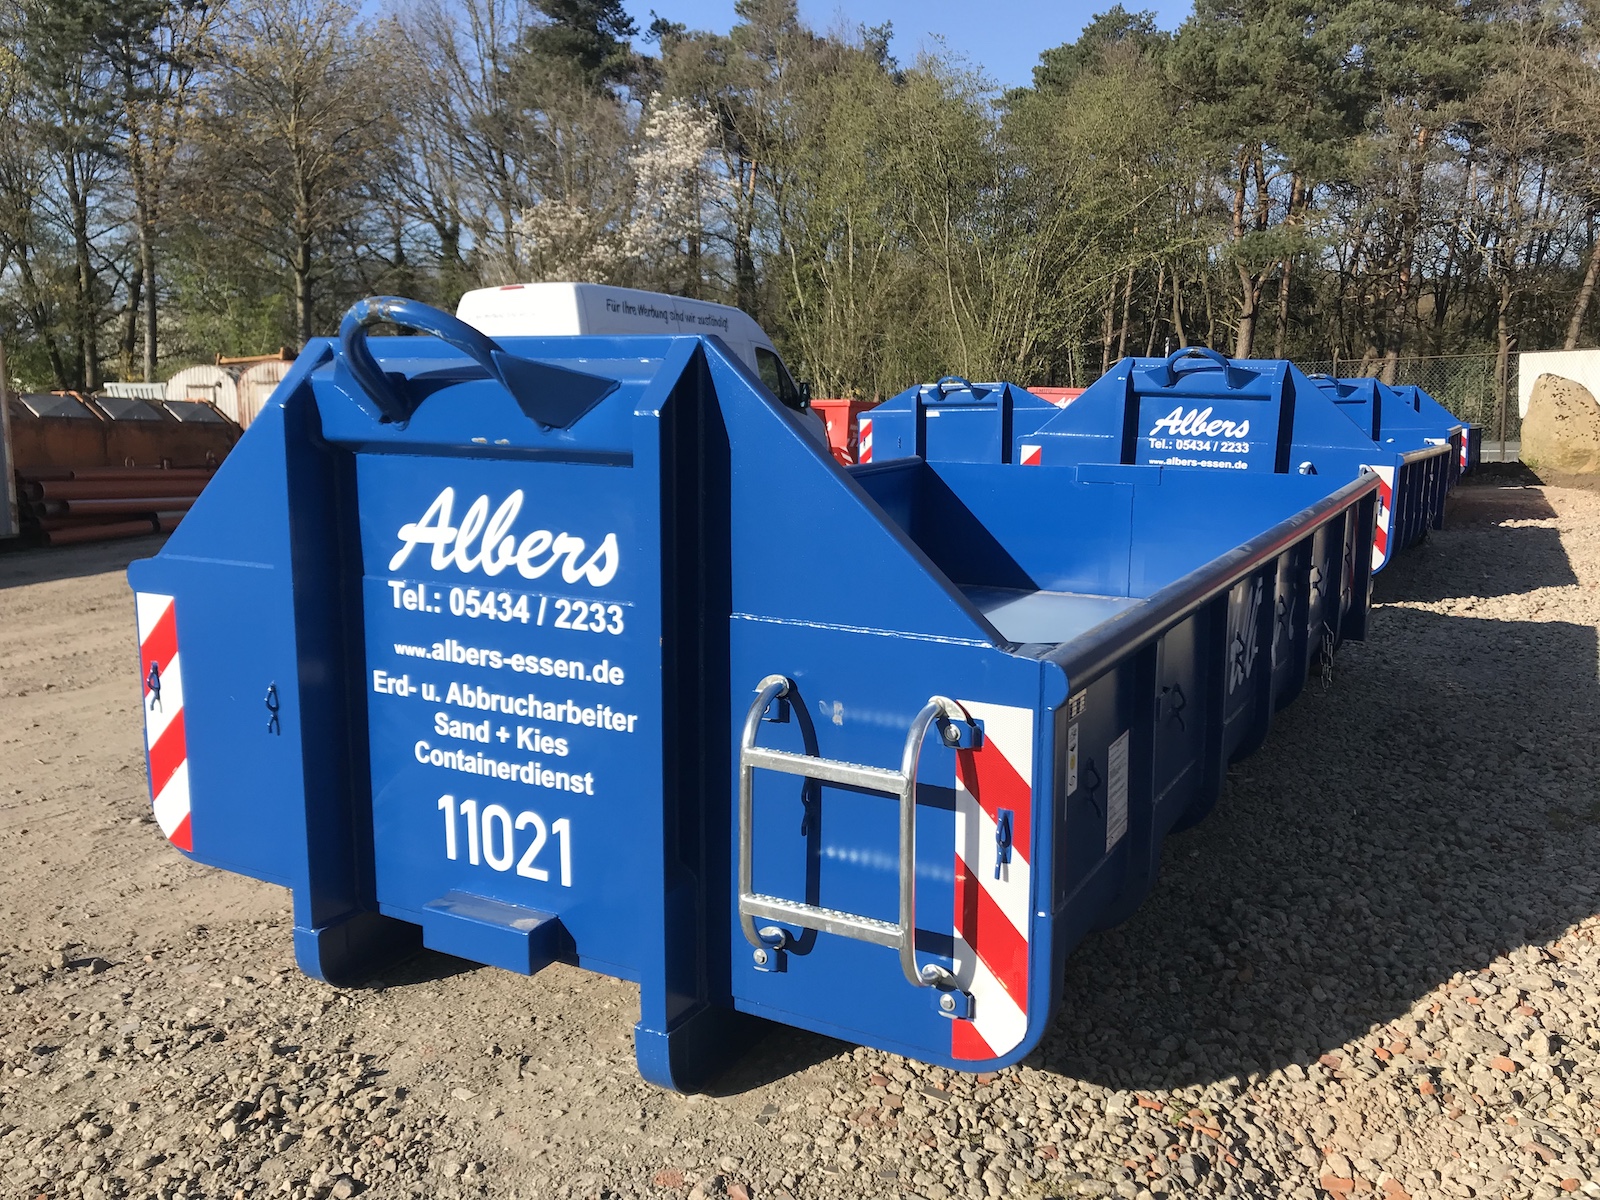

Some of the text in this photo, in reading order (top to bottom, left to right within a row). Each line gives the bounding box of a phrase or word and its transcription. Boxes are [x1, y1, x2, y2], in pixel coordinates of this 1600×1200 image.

[605, 298, 621, 312] Für
[622, 301, 637, 315] Ihre
[638, 304, 668, 325] Werbung
[669, 310, 685, 323] sind
[685, 313, 696, 324] wir
[1149, 438, 1250, 454] Tel.: 05434 / 2233
[1150, 406, 1250, 439] Albers
[1148, 456, 1249, 470] www.albers-essen.de
[388, 486, 619, 587] Albers
[387, 579, 625, 635] Tel.: 05434 / 2233
[393, 638, 625, 686] www.albers-essen.de
[373, 669, 638, 733] Erd- u. Abbrucharbeiter
[434, 711, 569, 757] Sand + Kies
[414, 740, 594, 796] Containerdienst
[437, 794, 572, 888] 11021
